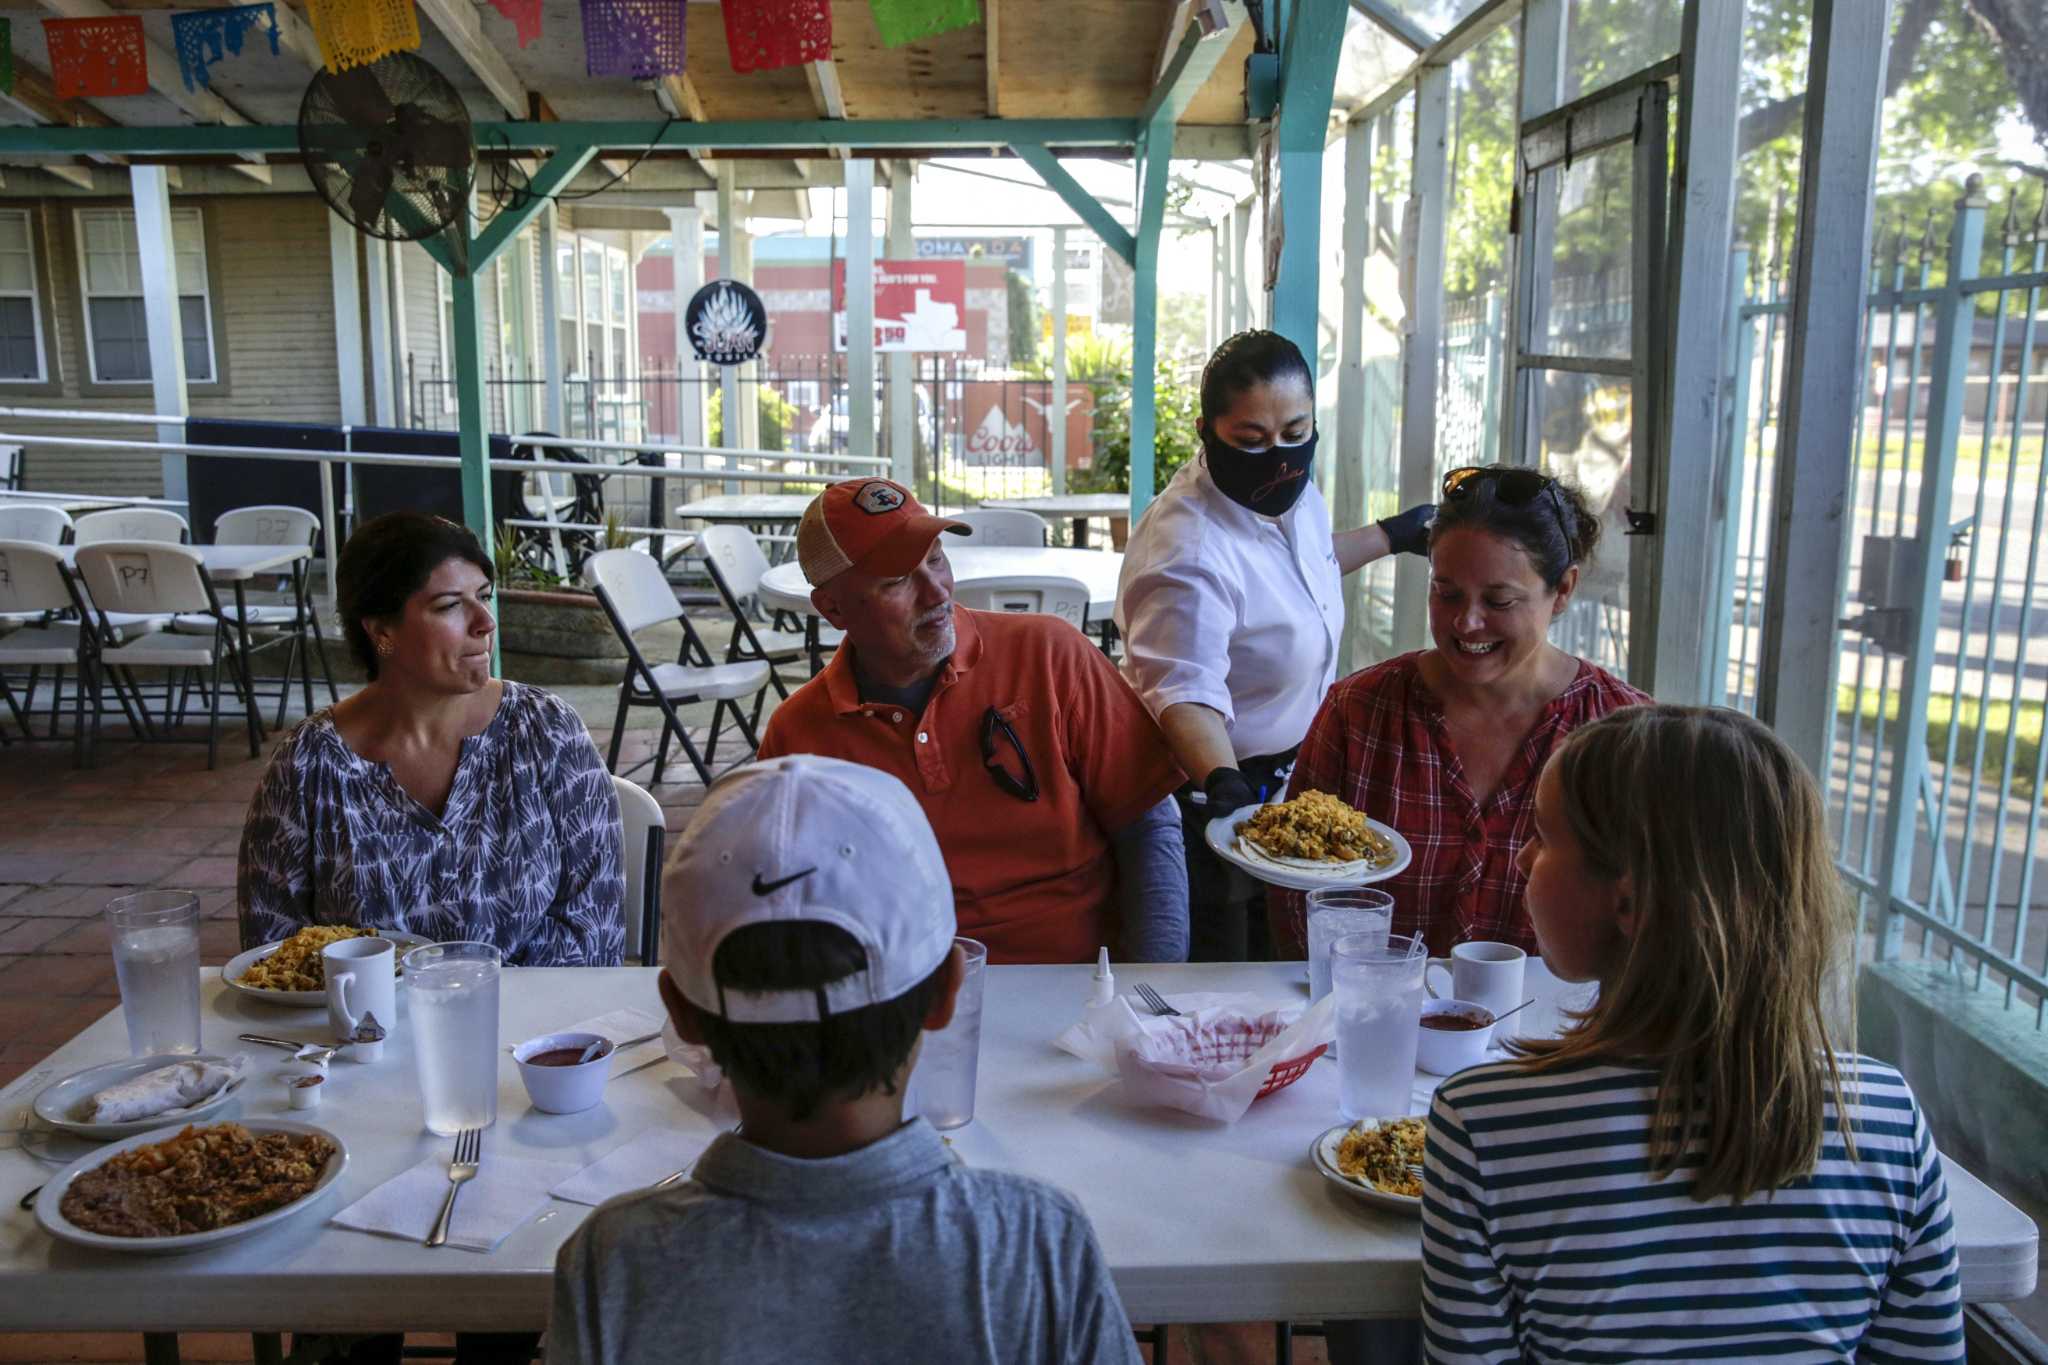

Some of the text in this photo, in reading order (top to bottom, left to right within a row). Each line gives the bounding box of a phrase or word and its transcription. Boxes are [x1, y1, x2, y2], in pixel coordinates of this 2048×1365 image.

[966, 425, 1034, 452] Coors
[978, 453, 1026, 465] LIGHT
[119, 566, 148, 587] P7
